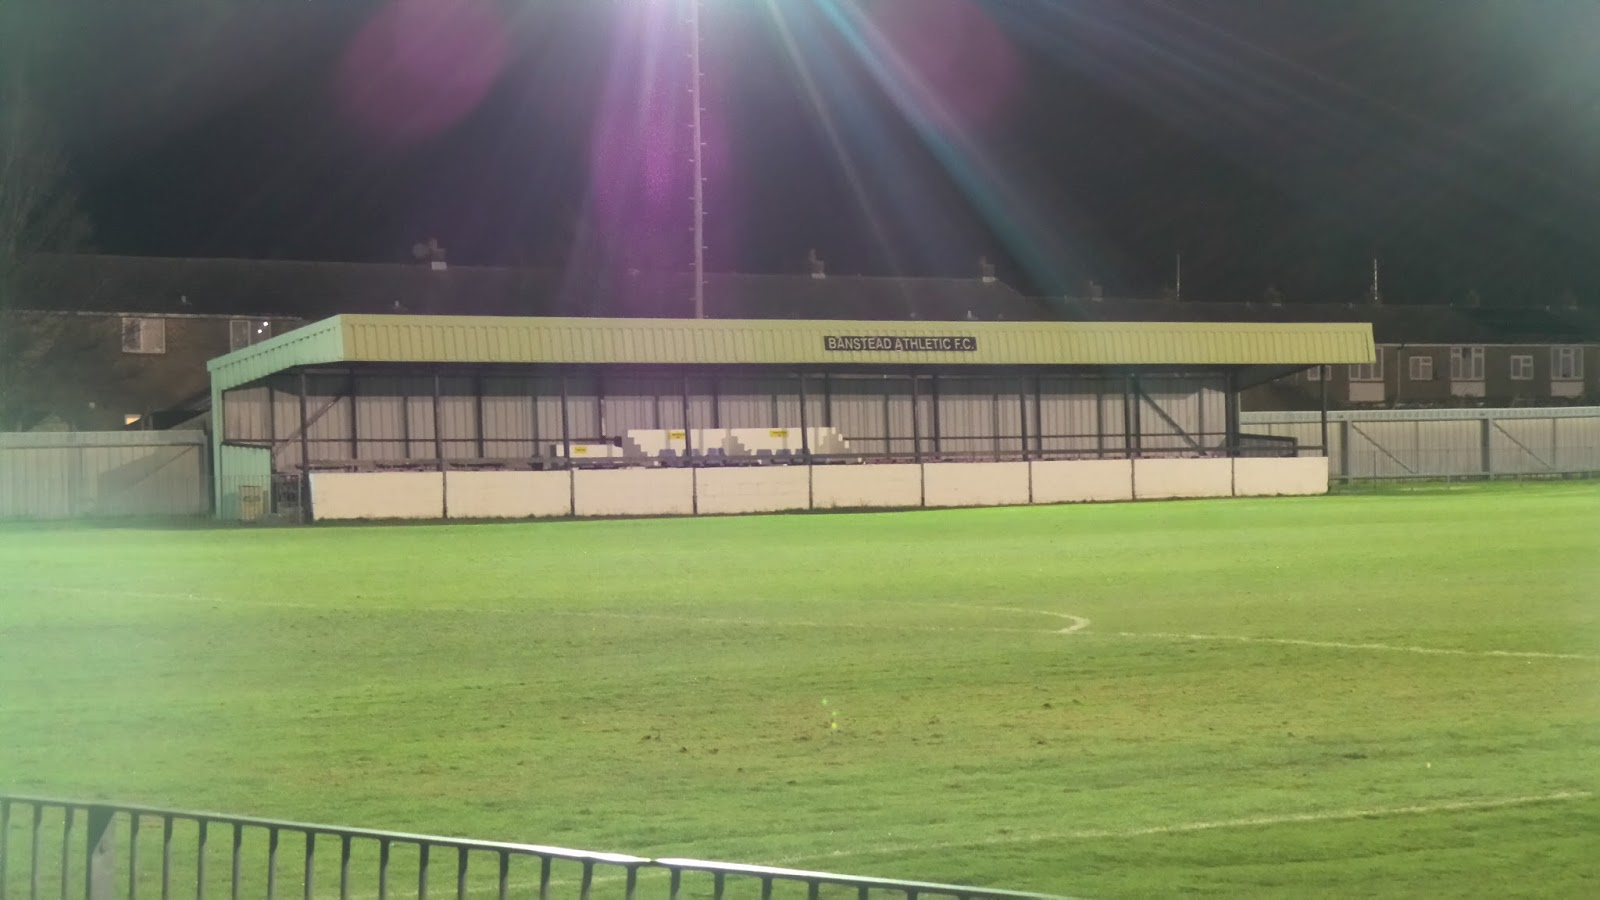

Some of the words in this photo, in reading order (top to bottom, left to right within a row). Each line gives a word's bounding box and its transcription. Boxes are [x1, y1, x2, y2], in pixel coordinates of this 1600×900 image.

[828, 337, 892, 350] BANSTEAD
[895, 338, 951, 350] ATHLETIC
[954, 338, 974, 350] F.C.
